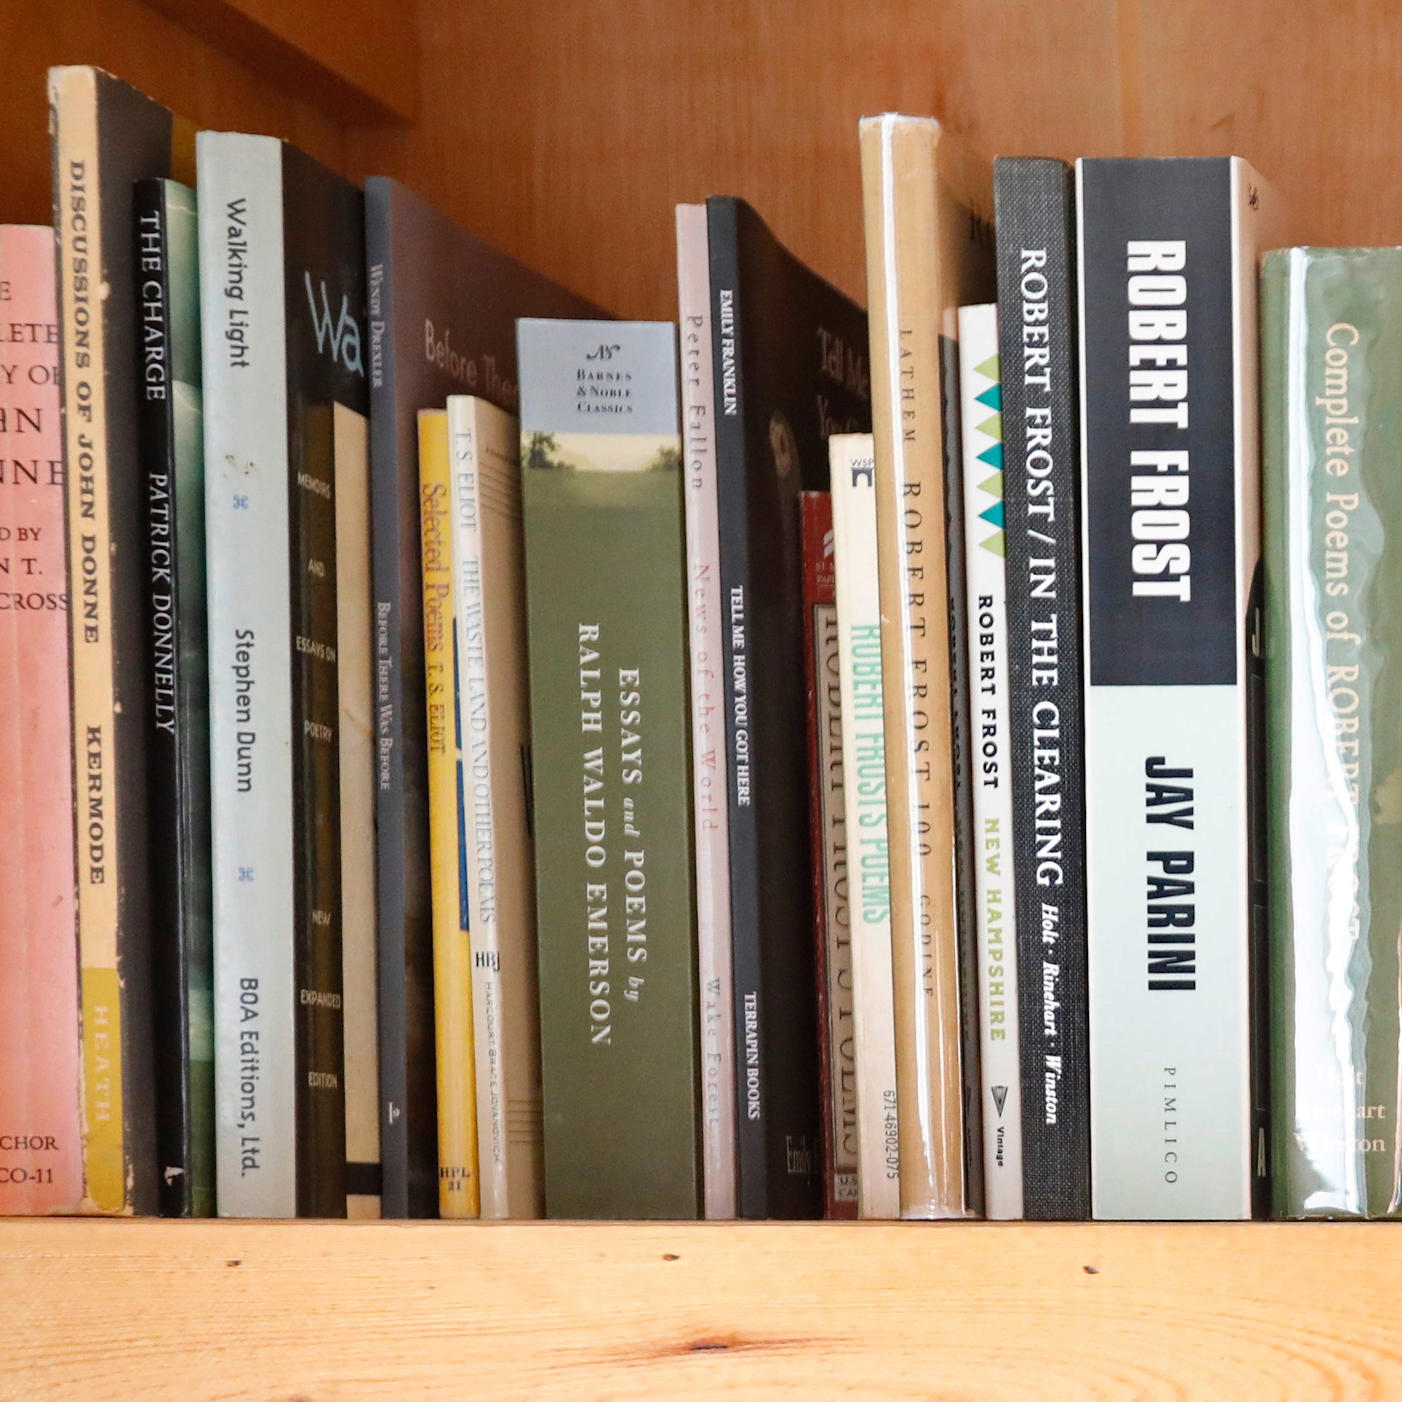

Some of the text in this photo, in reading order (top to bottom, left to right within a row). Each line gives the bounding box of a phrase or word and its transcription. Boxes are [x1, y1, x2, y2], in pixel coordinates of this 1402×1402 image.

[141, 211, 167, 399] THE CHARGE
[224, 198, 249, 367] Walking Light
[721, 289, 737, 416] EMILY FRANKLIN
[70, 161, 98, 643] DISCUSSIONS OF JOHN DONNE
[1127, 240, 1191, 602] ROBERT FROST
[1315, 324, 1360, 645] Complete Poems of
[150, 473, 174, 734] PATRICK DONNELLY
[1021, 247, 1063, 886] ROBERT FROST IN THE CLEARING
[232, 630, 255, 792] Stephen Dunn
[979, 596, 998, 788] ROBERT FROST
[87, 726, 104, 884] KERMODE
[579, 624, 611, 1044] RALPH WALDO EMERSON
[619, 669, 647, 1001] ESSAYS and POEMS by
[1144, 757, 1196, 992] JAY PARINI
[985, 819, 1006, 1041] NEW HAMPSHIRE
[237, 979, 260, 1176] BOA Editions, Ltd.
[744, 992, 760, 1119] TERRAPIN BOOKS
[996, 1127, 1004, 1166] Vintage
[1164, 1068, 1177, 1183] PIMLICO
